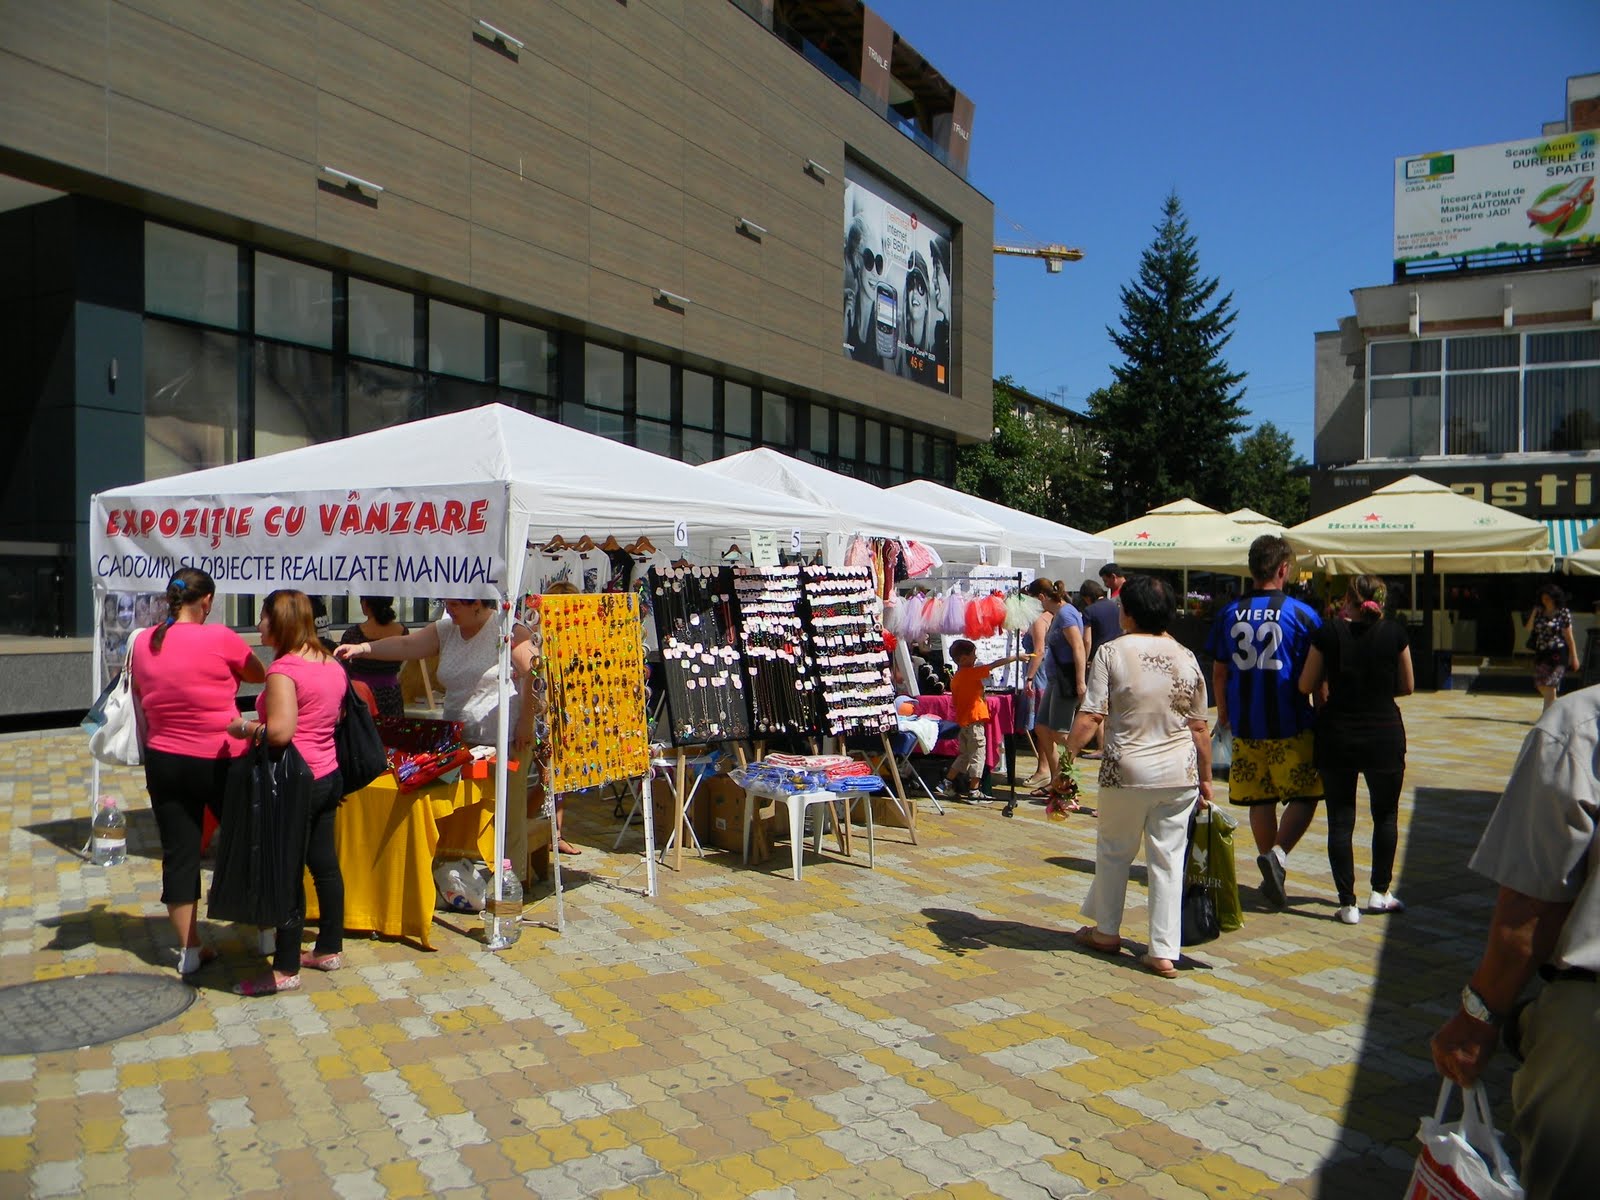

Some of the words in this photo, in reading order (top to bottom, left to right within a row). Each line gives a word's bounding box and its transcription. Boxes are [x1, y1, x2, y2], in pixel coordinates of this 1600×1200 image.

[1544, 142, 1576, 152] Acum
[1581, 137, 1596, 147] de
[1513, 152, 1577, 169] DURERILE
[1581, 150, 1596, 160] de
[1546, 161, 1595, 177] SPATE!
[1484, 188, 1511, 199] Patul
[1513, 187, 1526, 196] de
[1440, 204, 1469, 215] Masaj
[1472, 196, 1523, 212] AUTOMAT
[1440, 216, 1453, 224] cu
[1455, 212, 1484, 222] Pietre
[1487, 208, 1511, 217] JAD!
[263, 503, 308, 537] CU
[319, 490, 490, 536] VÂNZARE
[676, 521, 686, 542] 6
[1327, 521, 1416, 530] Heineken
[791, 531, 801, 548] 5
[1112, 539, 1178, 548] eineken
[97, 554, 176, 580] CADOURI
[200, 556, 276, 581] OBIECTE
[281, 556, 390, 582] REALIZATE
[395, 555, 499, 584] MANUAL
[1235, 608, 1281, 621] VIERI
[1230, 621, 1284, 671] 32
